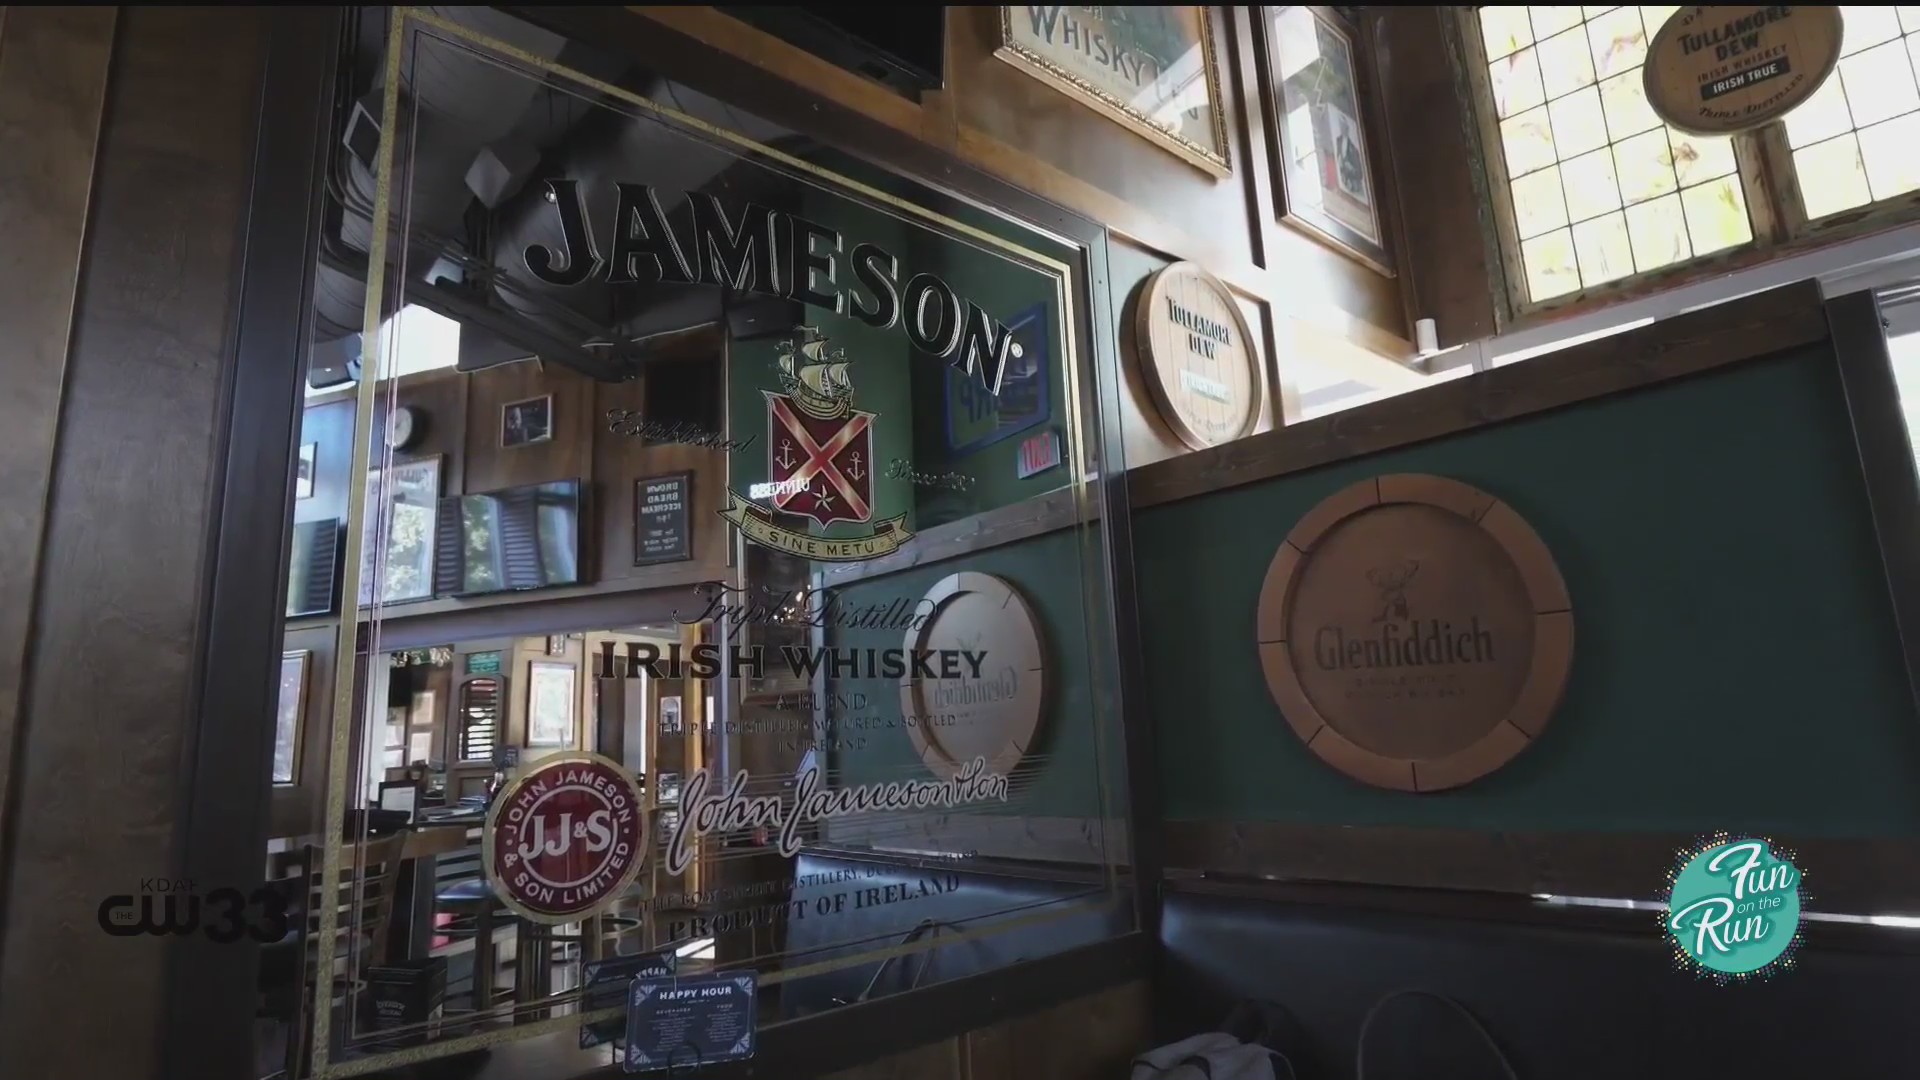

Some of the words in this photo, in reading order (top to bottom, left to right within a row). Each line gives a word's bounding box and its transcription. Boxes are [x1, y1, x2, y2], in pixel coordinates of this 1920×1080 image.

[1027, 6, 1145, 87] WHISKY
[1676, 8, 1793, 55] TULLAMORE
[1714, 32, 1760, 62] DEW
[1713, 73, 1745, 94] IRISH
[1749, 63, 1778, 82] TRUE
[523, 178, 1012, 397] JAMESON
[769, 531, 816, 554] SINE
[826, 541, 874, 556] METU
[599, 641, 764, 679] IRISH
[781, 645, 988, 679] WHISKEY
[1313, 616, 1496, 671] Glenfiddich
[901, 714, 956, 728] BOTLED
[803, 737, 868, 752] IREAND
[504, 780, 548, 835] JOHN
[555, 770, 632, 824] JAMESON
[665, 768, 783, 875] John
[517, 809, 613, 860] JJ&S
[514, 871, 555, 903] SON
[562, 842, 630, 904] LIMITED
[816, 893, 848, 916] OF
[855, 874, 960, 910] IRELAND
[659, 989, 697, 1001] HAPPY
[701, 985, 733, 997] HOUR
